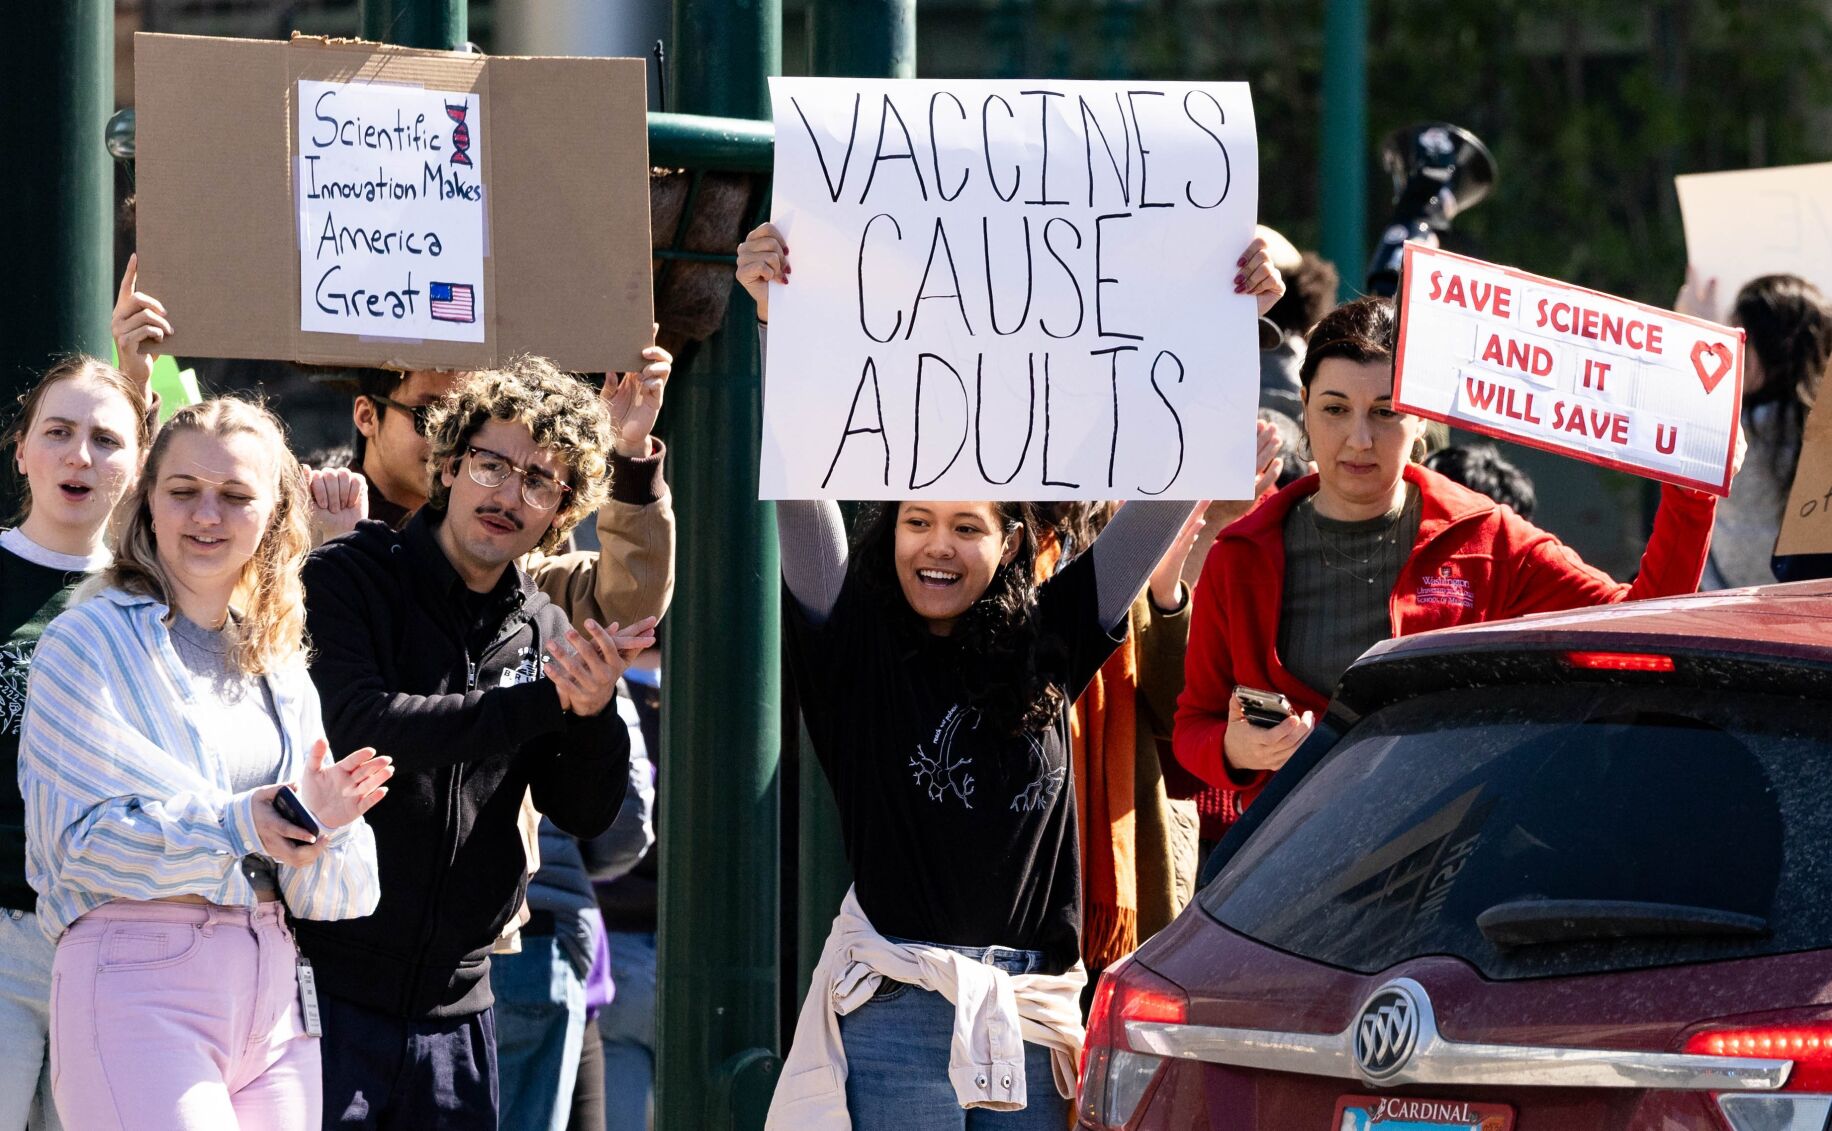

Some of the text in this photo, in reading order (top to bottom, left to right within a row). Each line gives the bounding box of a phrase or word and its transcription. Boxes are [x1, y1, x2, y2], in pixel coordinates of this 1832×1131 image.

[312, 91, 441, 151] Scientific
[791, 90, 1231, 210] VACCINES
[305, 155, 481, 203] Innovation Makes
[316, 211, 442, 260] America
[315, 266, 420, 320] Great
[857, 213, 1145, 343] CAUSE
[1429, 271, 1663, 354] SAVE SCIENCE
[1482, 334, 1611, 391] AND IT
[821, 345, 1185, 496] ADULTS
[1466, 377, 1677, 455] WILL SAVE U
[1387, 1098, 1470, 1123] CARDINAL
